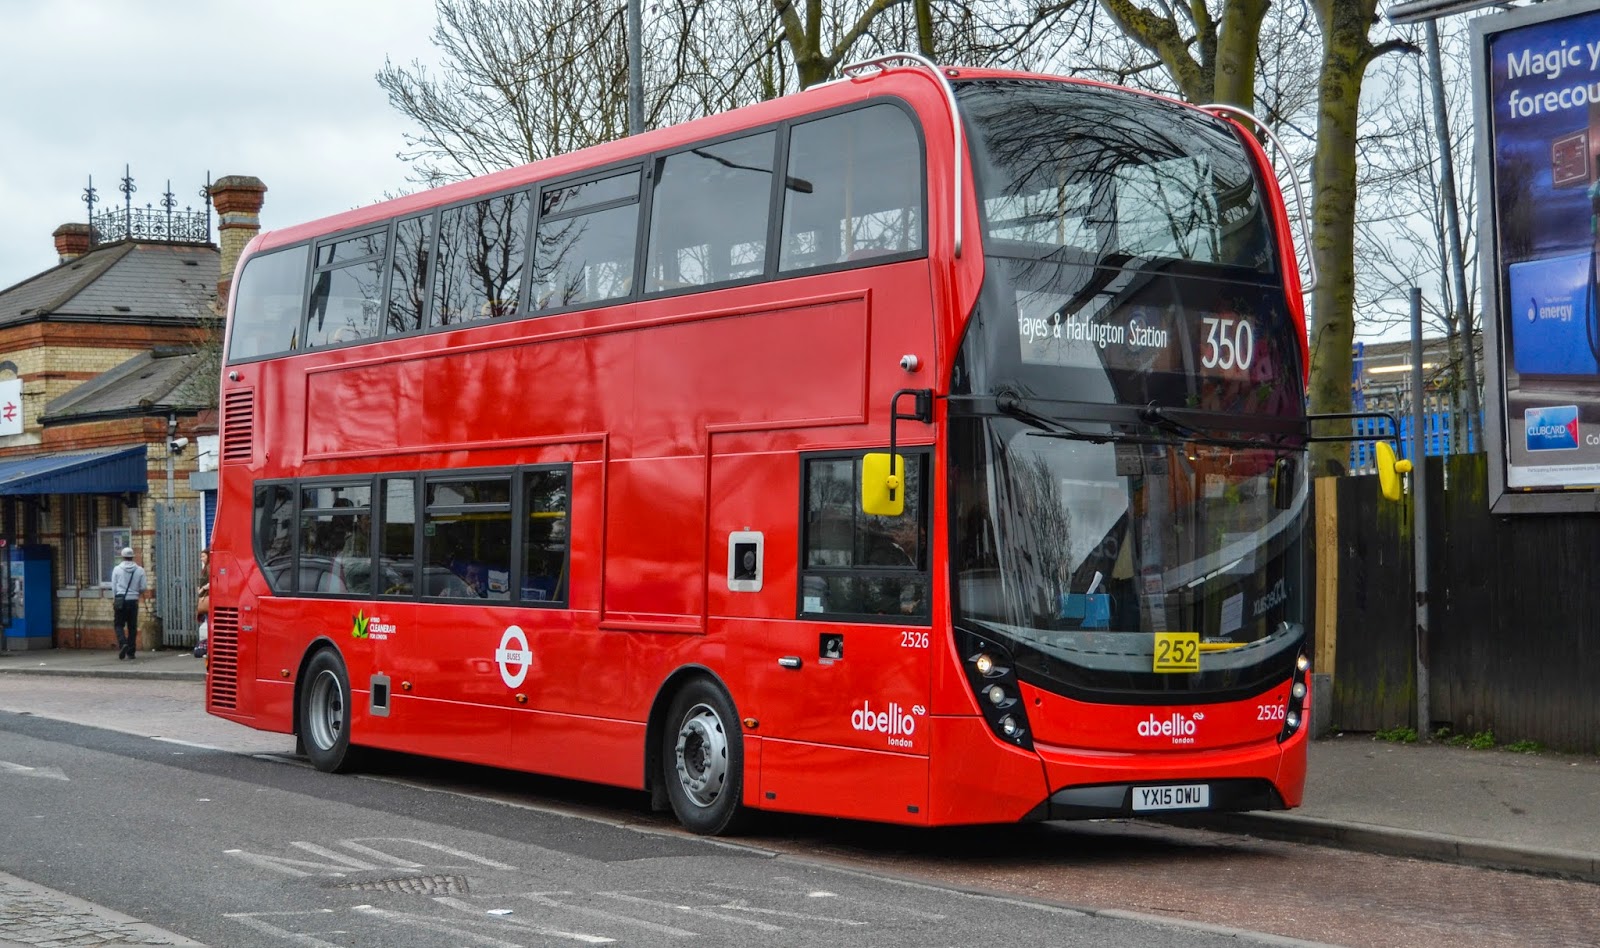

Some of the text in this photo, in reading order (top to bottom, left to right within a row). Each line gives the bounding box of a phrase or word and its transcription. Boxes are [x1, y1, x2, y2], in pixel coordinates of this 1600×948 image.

[1507, 40, 1581, 80] Magic
[1508, 82, 1600, 119] forecou
[1540, 304, 1572, 322] energy
[1053, 312, 1062, 338] &
[1066, 313, 1124, 349] Harlington
[1129, 319, 1167, 348] Station
[1201, 317, 1253, 371] 350
[1527, 425, 1566, 436] CLUBCARD
[901, 631, 929, 649] 2526
[507, 652, 521, 661] BUSES
[1157, 640, 1197, 663] 252
[851, 700, 915, 736] abellio
[1257, 704, 1285, 720] 2526
[1137, 713, 1196, 736] abellio
[888, 736, 913, 747] london
[1142, 787, 1201, 806] YX15 OWU
